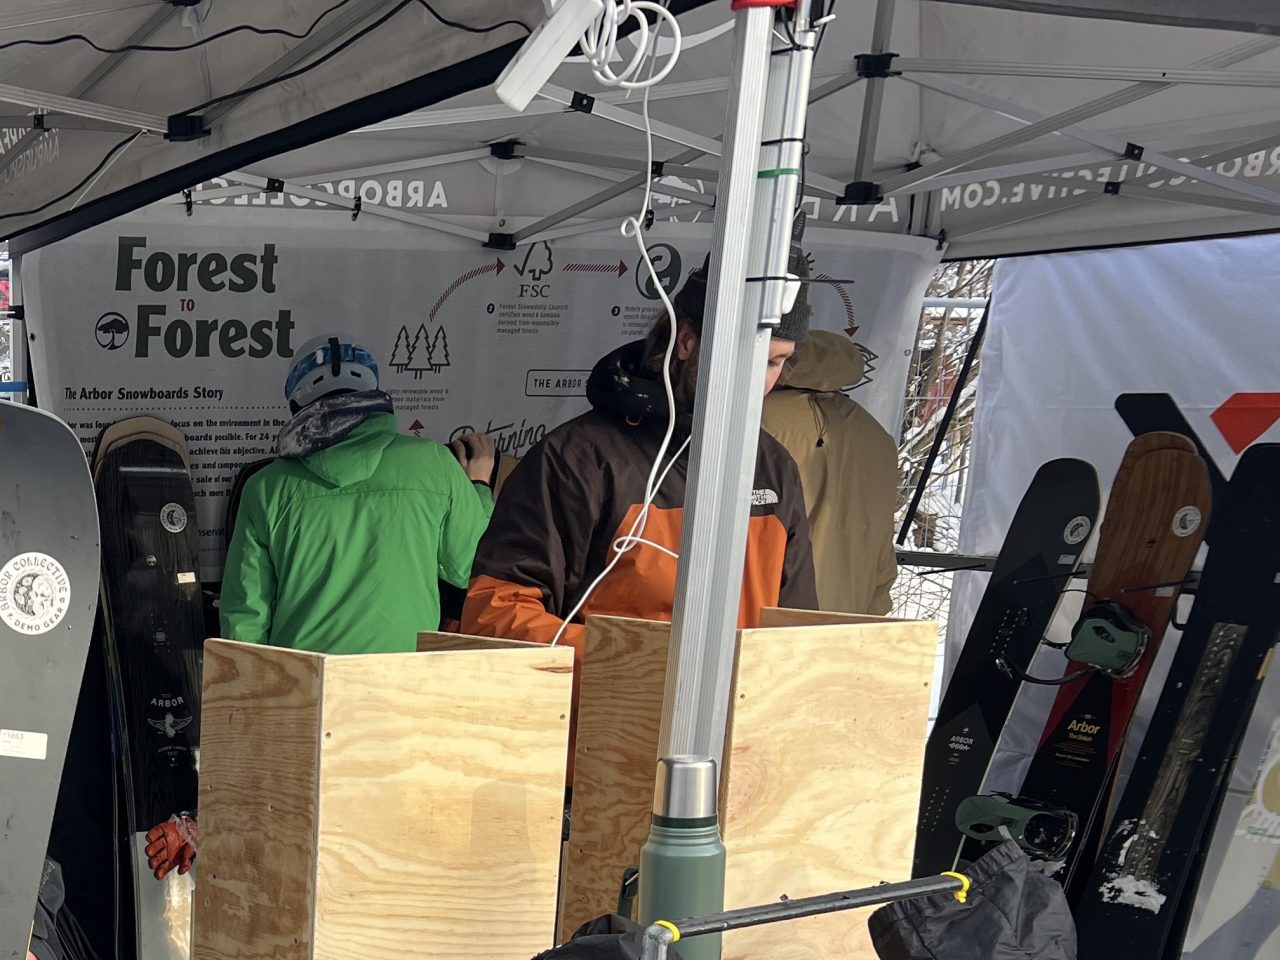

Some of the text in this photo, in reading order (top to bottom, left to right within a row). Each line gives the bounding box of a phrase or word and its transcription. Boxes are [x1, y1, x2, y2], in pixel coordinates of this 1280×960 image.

[115, 236, 278, 293] Forest
[518, 284, 551, 298] FSC
[180, 299, 195, 311] TO
[134, 305, 294, 359] Forest
[534, 379, 551, 388] THE
[556, 379, 582, 388] ARBOR
[65, 386, 224, 401] The Arbor Snowboards Story
[171, 420, 190, 428] focus
[206, 419, 217, 427] the
[220, 419, 261, 427] environment
[273, 418, 285, 426] the
[259, 433, 269, 441] 24
[220, 447, 230, 455] this
[202, 461, 216, 469] and
[196, 475, 213, 483] sale
[13, 556, 68, 594] COLLECTIVE
[14, 607, 64, 631] DEMO GEAR
[150, 696, 184, 707] ARBOR
[1067, 720, 1101, 735] Arbor
[950, 735, 974, 745] ARBOR
